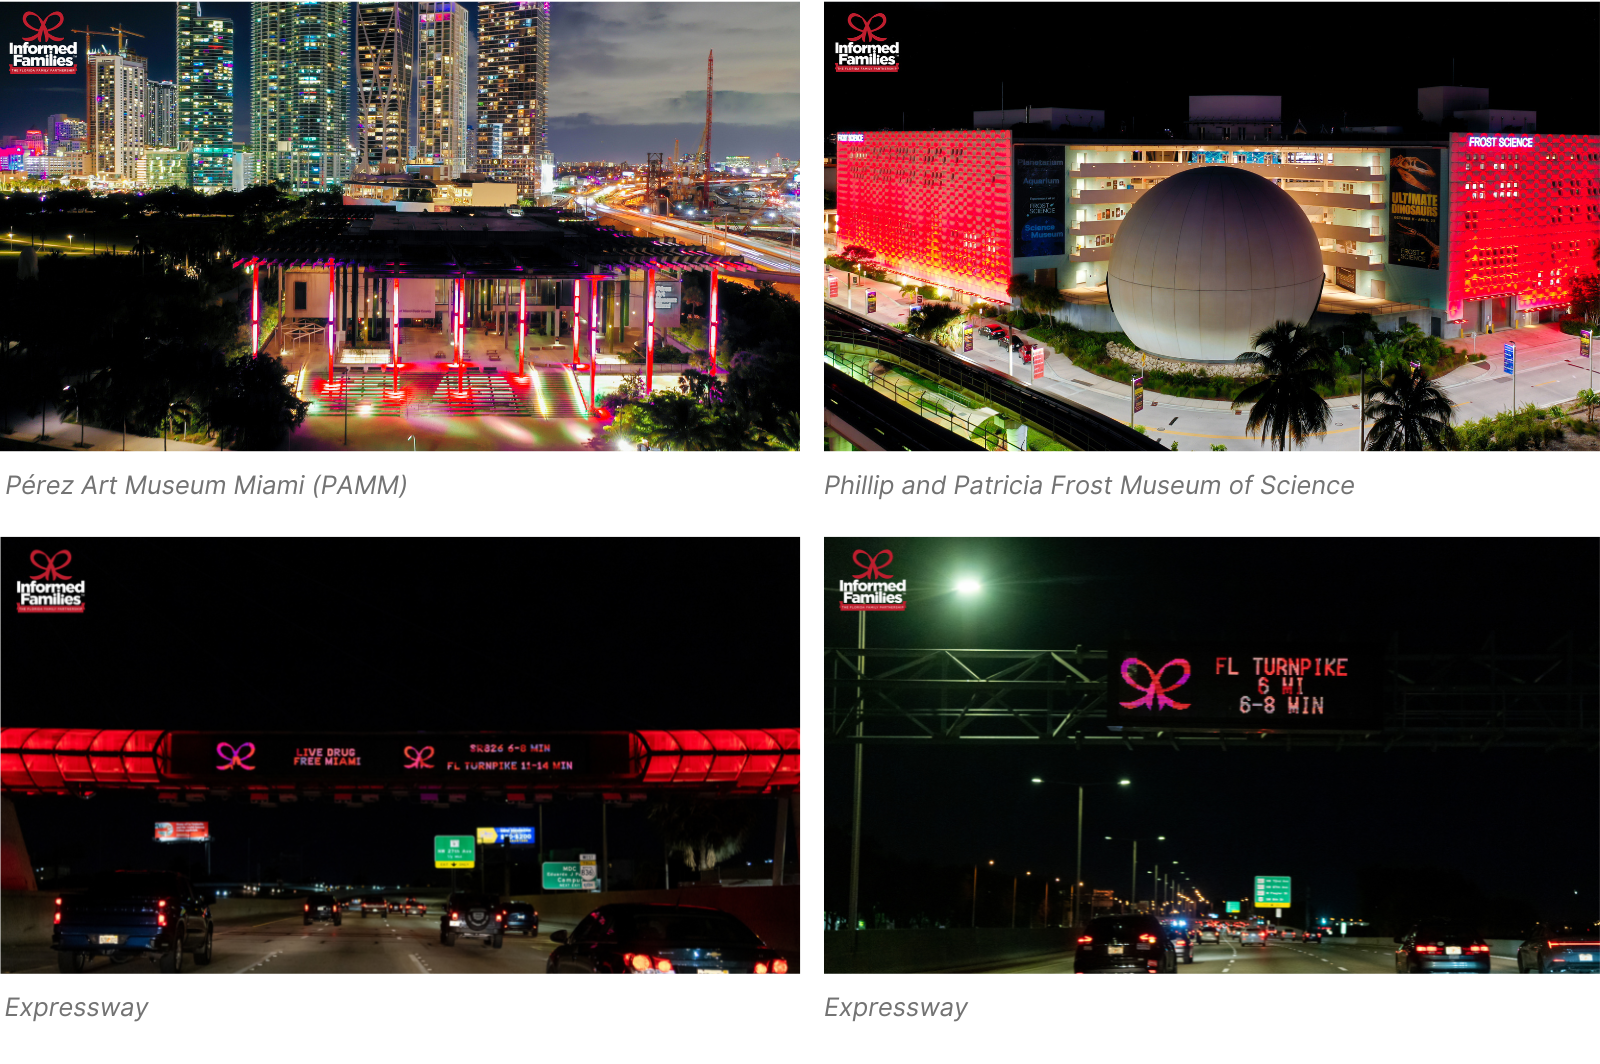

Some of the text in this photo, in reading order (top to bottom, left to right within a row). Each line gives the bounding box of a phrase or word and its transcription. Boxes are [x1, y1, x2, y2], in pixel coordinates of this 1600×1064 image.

[1469, 137, 1533, 147] FROST SCIENCE
[1392, 192, 1438, 206] ULTIMATE
[1392, 204, 1438, 217] DINOSAURS
[1216, 657, 1348, 676] FL TURNPIKE
[1258, 677, 1303, 694] 6 MI
[1240, 696, 1324, 714] 6-8 MIN
[296, 748, 356, 756] LIVE DRUG
[470, 744, 550, 752] SR826 6-8 MIN
[294, 757, 361, 766] FREE MIAMI
[447, 761, 573, 770] FL TURNPIKE 11-14 MIN
